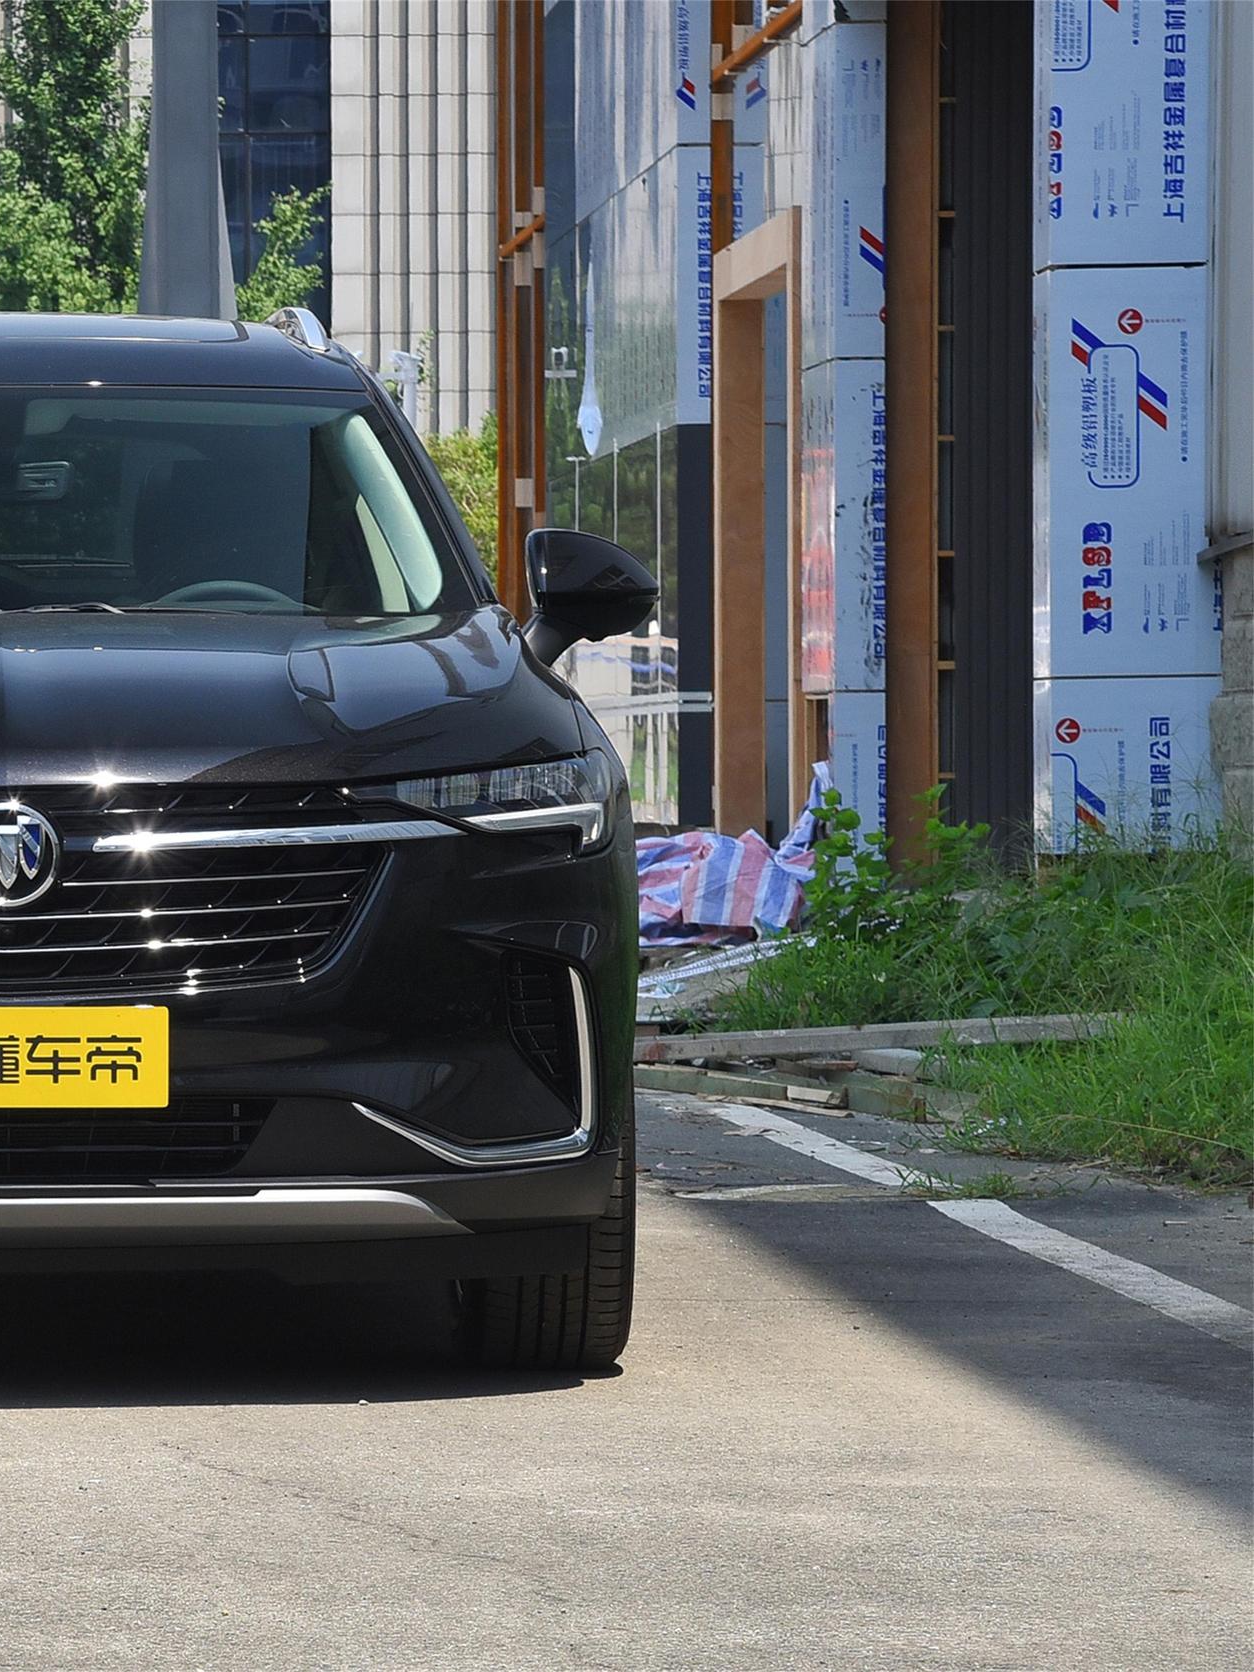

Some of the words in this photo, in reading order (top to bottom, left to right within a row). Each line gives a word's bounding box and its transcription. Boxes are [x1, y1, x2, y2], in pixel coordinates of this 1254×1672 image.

[1162, 0, 1187, 223] 上海吉祥金属复合材
[1080, 376, 1099, 469] 高级铝塑板
